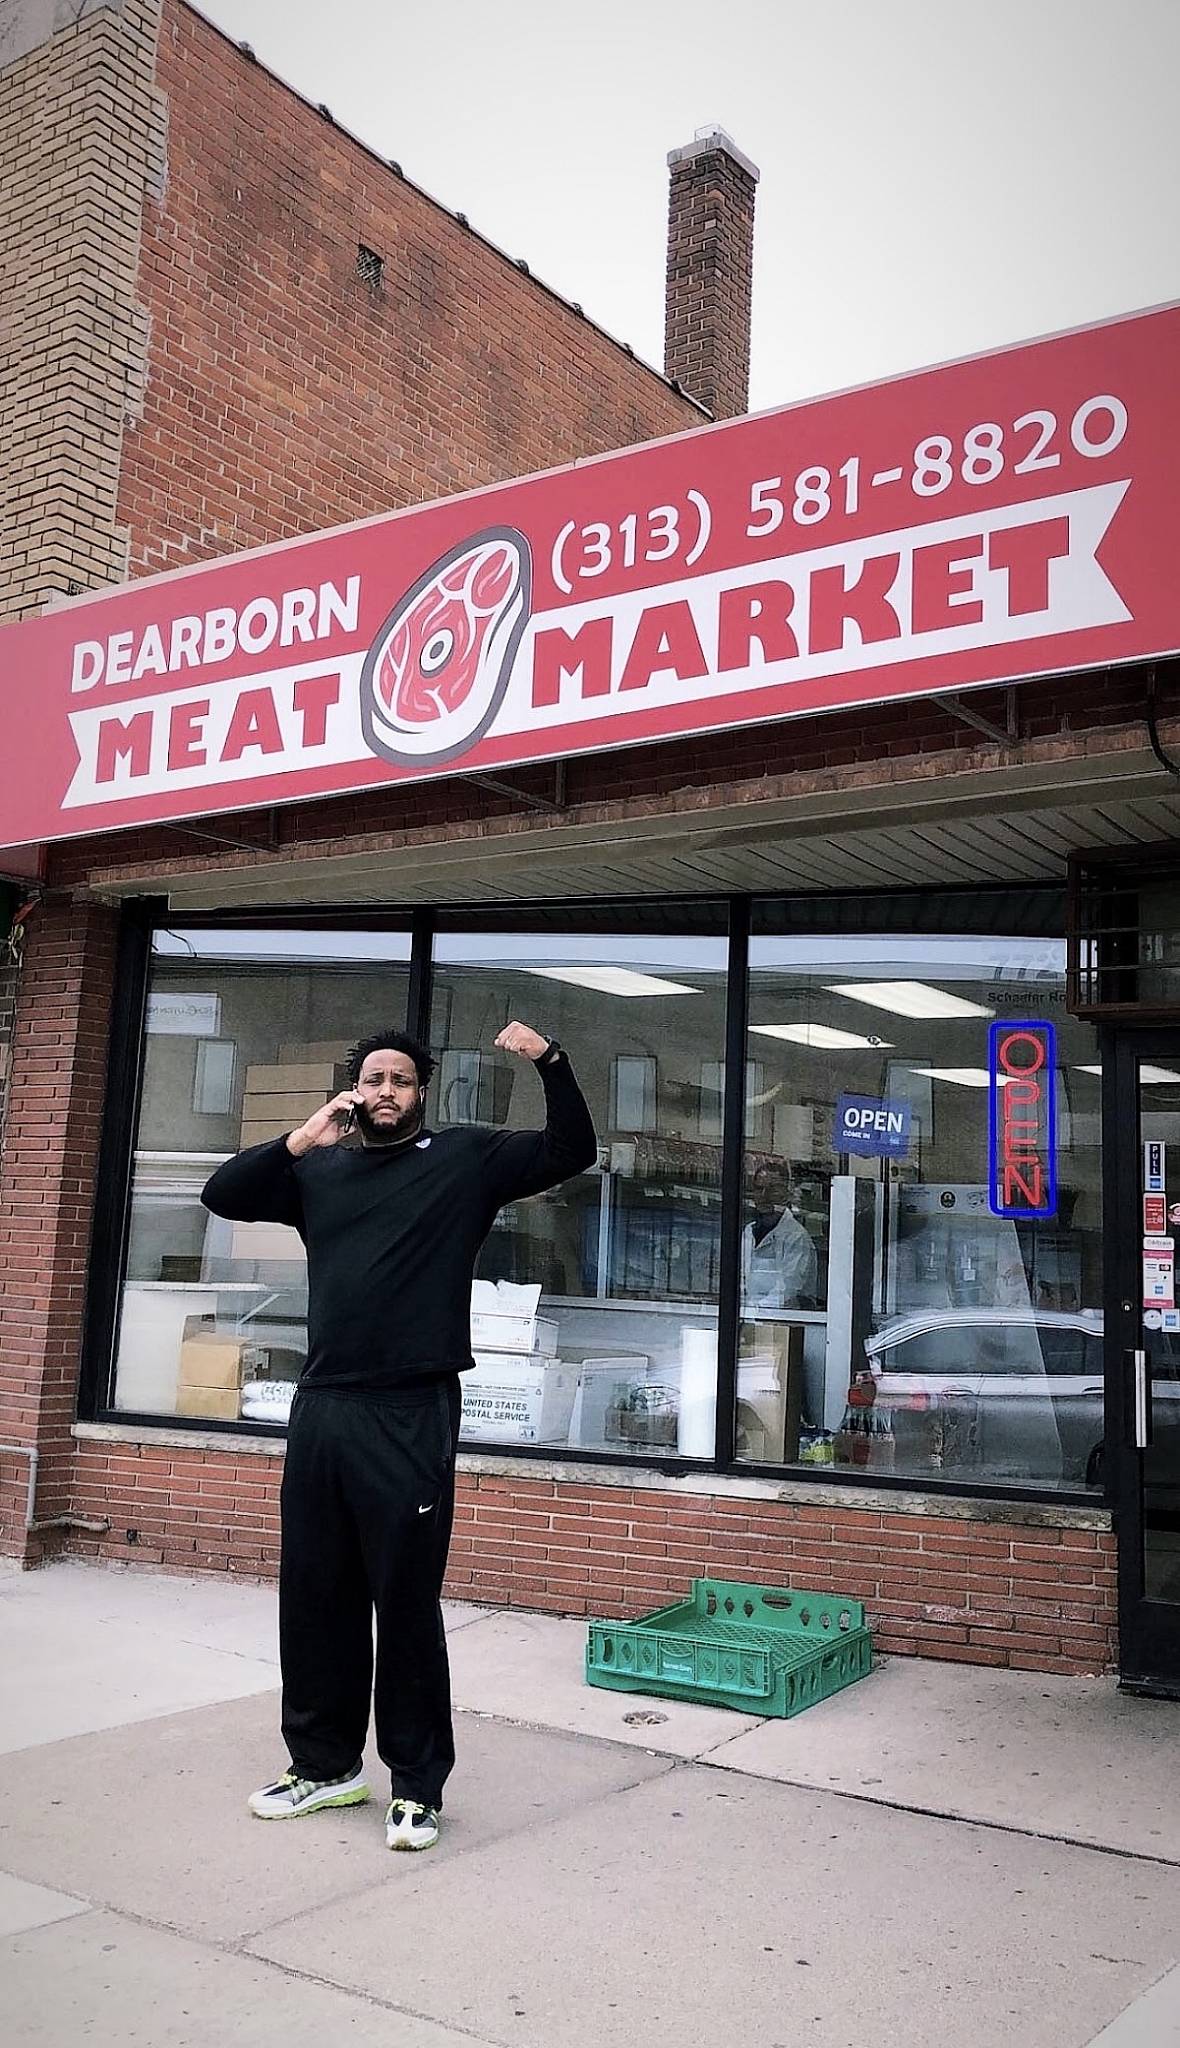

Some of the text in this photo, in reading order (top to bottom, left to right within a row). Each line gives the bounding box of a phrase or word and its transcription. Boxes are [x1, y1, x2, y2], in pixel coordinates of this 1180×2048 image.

[551, 394, 1128, 594] (313) 581-8820
[70, 575, 362, 693] DEARBORN
[95, 516, 1070, 784] MEAT MARKET
[844, 1107, 904, 1133] OPEN
[999, 1032, 1045, 1206] OPEN
[461, 1408, 492, 1420] POSTAL
[494, 1411, 531, 1423] SERVICE
[463, 1398, 528, 1411] UNITED STATES
